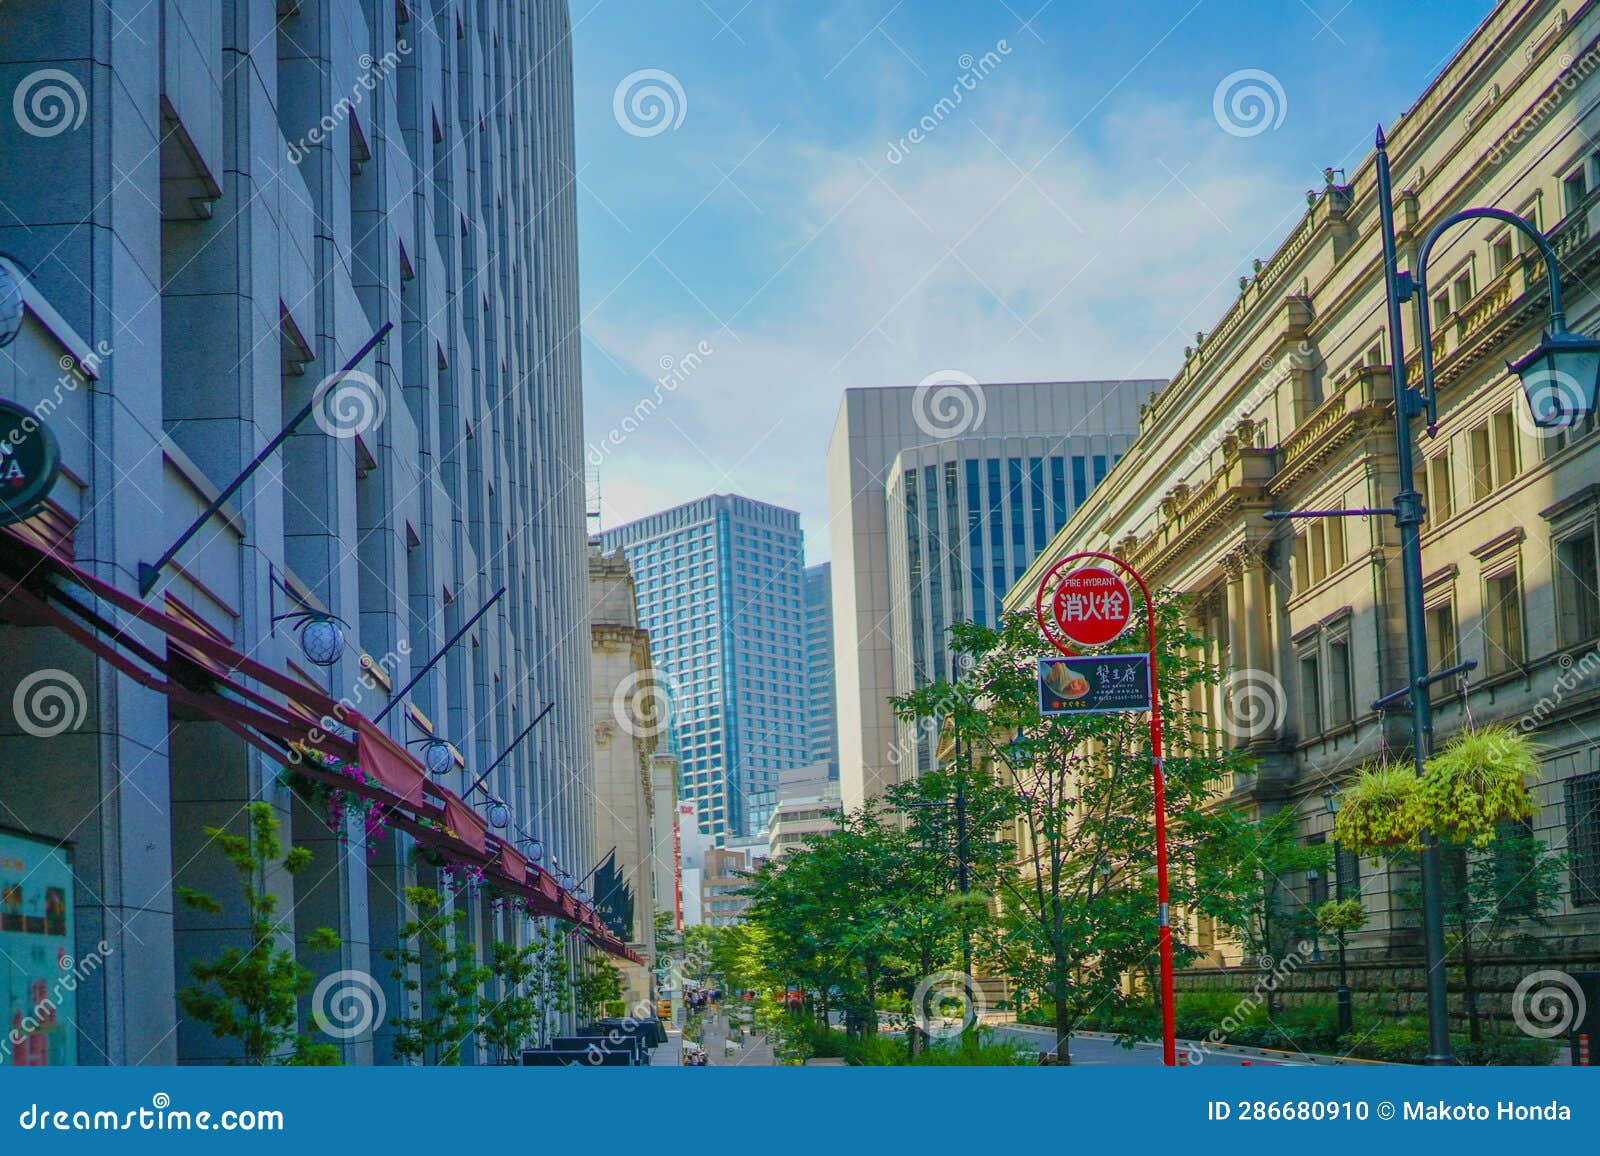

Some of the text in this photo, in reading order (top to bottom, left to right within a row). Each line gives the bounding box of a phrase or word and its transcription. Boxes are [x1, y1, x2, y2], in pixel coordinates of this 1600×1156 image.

[1065, 577, 1117, 588] FIRE HYDRANT
[1060, 591, 1124, 621] 消火栓
